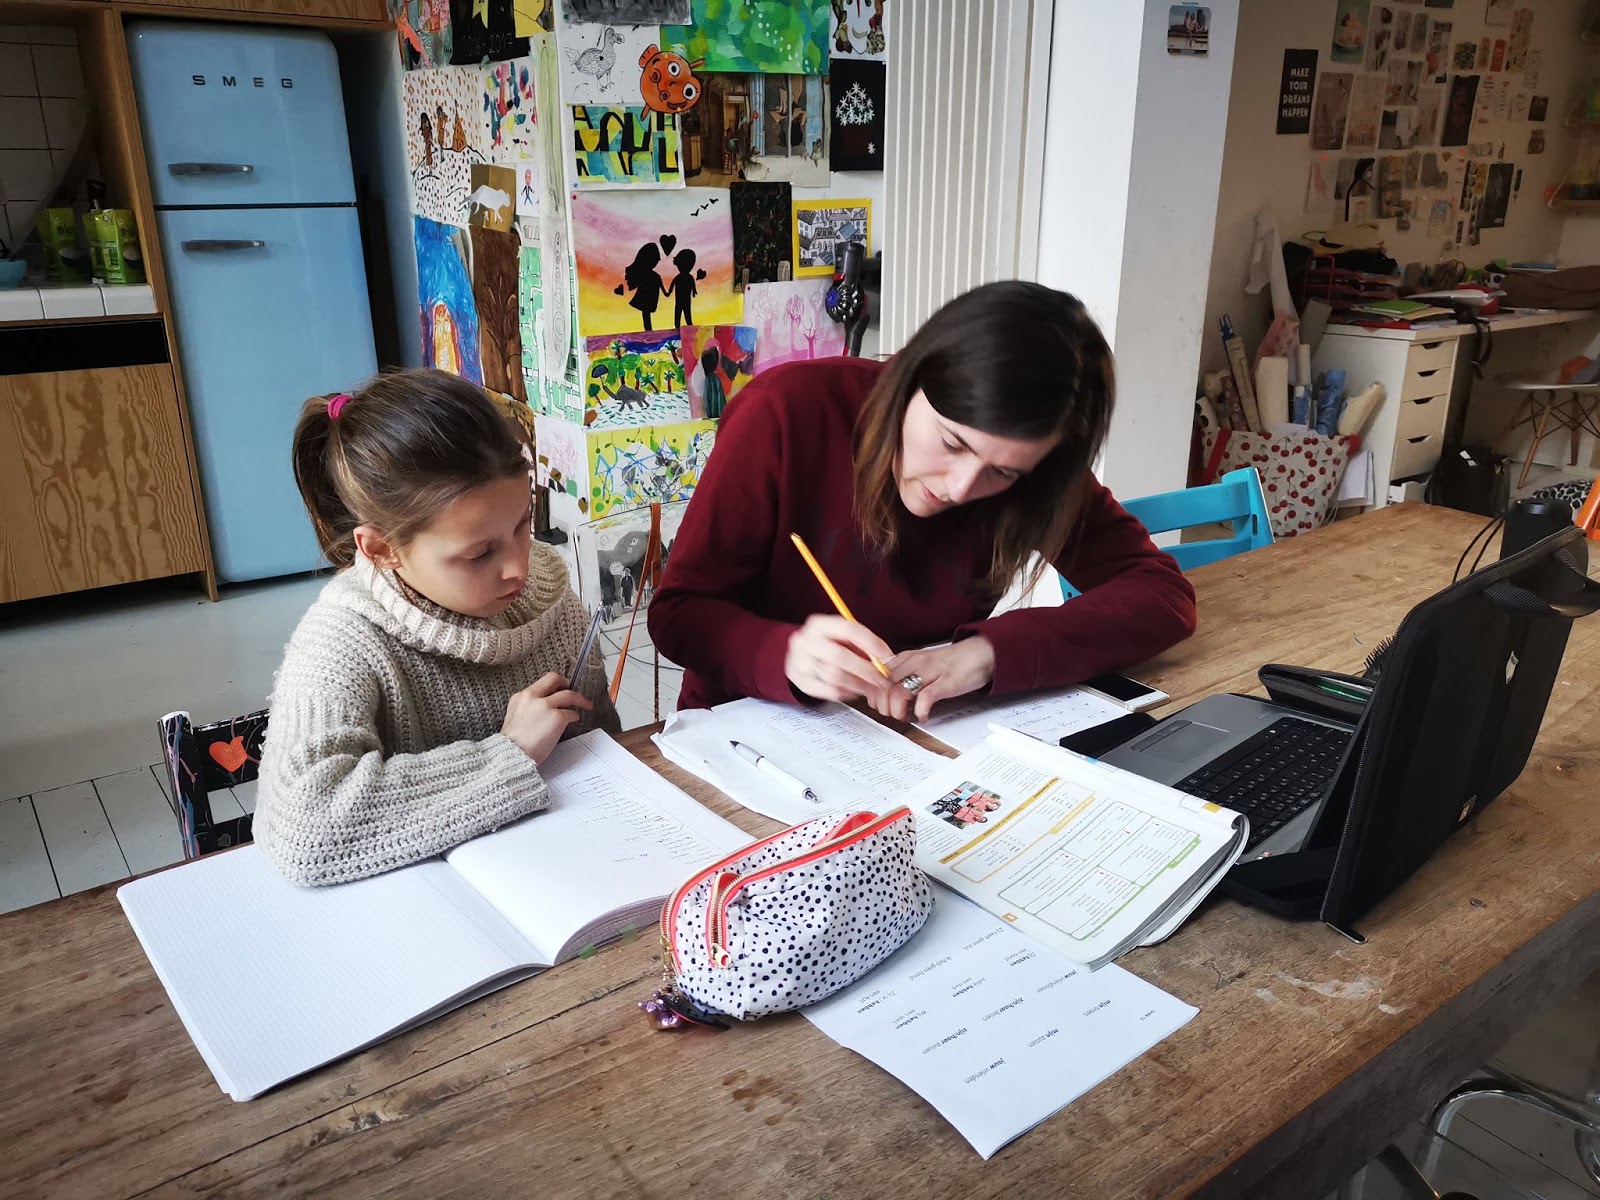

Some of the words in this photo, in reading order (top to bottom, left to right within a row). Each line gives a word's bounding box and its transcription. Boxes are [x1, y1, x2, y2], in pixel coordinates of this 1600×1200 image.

[488, 32, 514, 54] 2017
[1290, 67, 1310, 77] MAKE
[192, 74, 293, 89] SMEG
[1289, 81, 1308, 91] YOUR
[1282, 94, 1311, 104] DREAMS
[1281, 107, 1309, 118] HAPPEN
[1010, 955, 1030, 967] hebben
[923, 962, 937, 973] geen
[952, 985, 974, 997] hebben
[857, 1000, 880, 1013] hebben
[999, 997, 1024, 1013] zijn/haar
[1099, 999, 1111, 1009] mijn
[895, 1015, 918, 1029] hebben
[941, 1027, 967, 1045] zijn/haar
[1045, 1028, 1059, 1038] mijn
[989, 1057, 1006, 1070] jouw
[965, 1067, 990, 1084] vrienden
